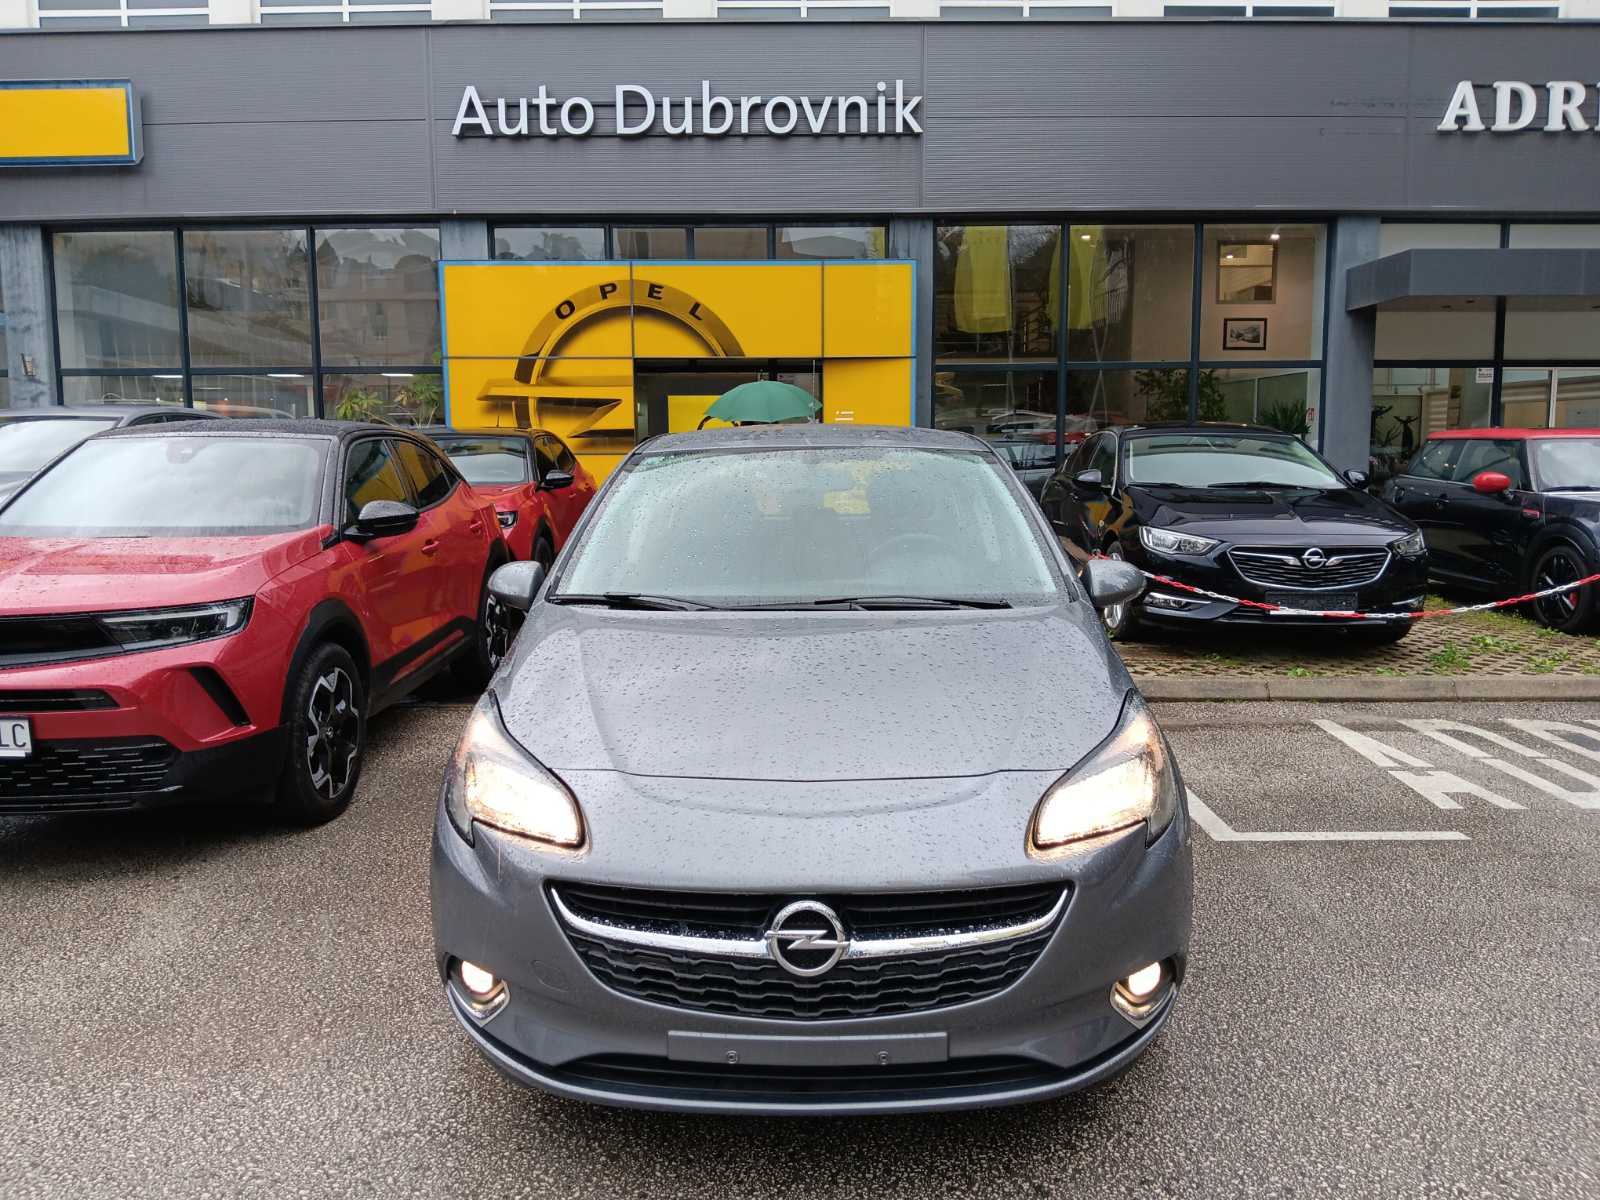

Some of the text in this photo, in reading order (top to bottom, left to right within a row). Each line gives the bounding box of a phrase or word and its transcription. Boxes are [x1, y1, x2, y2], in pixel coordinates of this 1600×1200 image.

[451, 79, 924, 136] Auto Dubrovnik
[1436, 79, 1600, 132] ADR
[554, 282, 703, 321] OPEL
